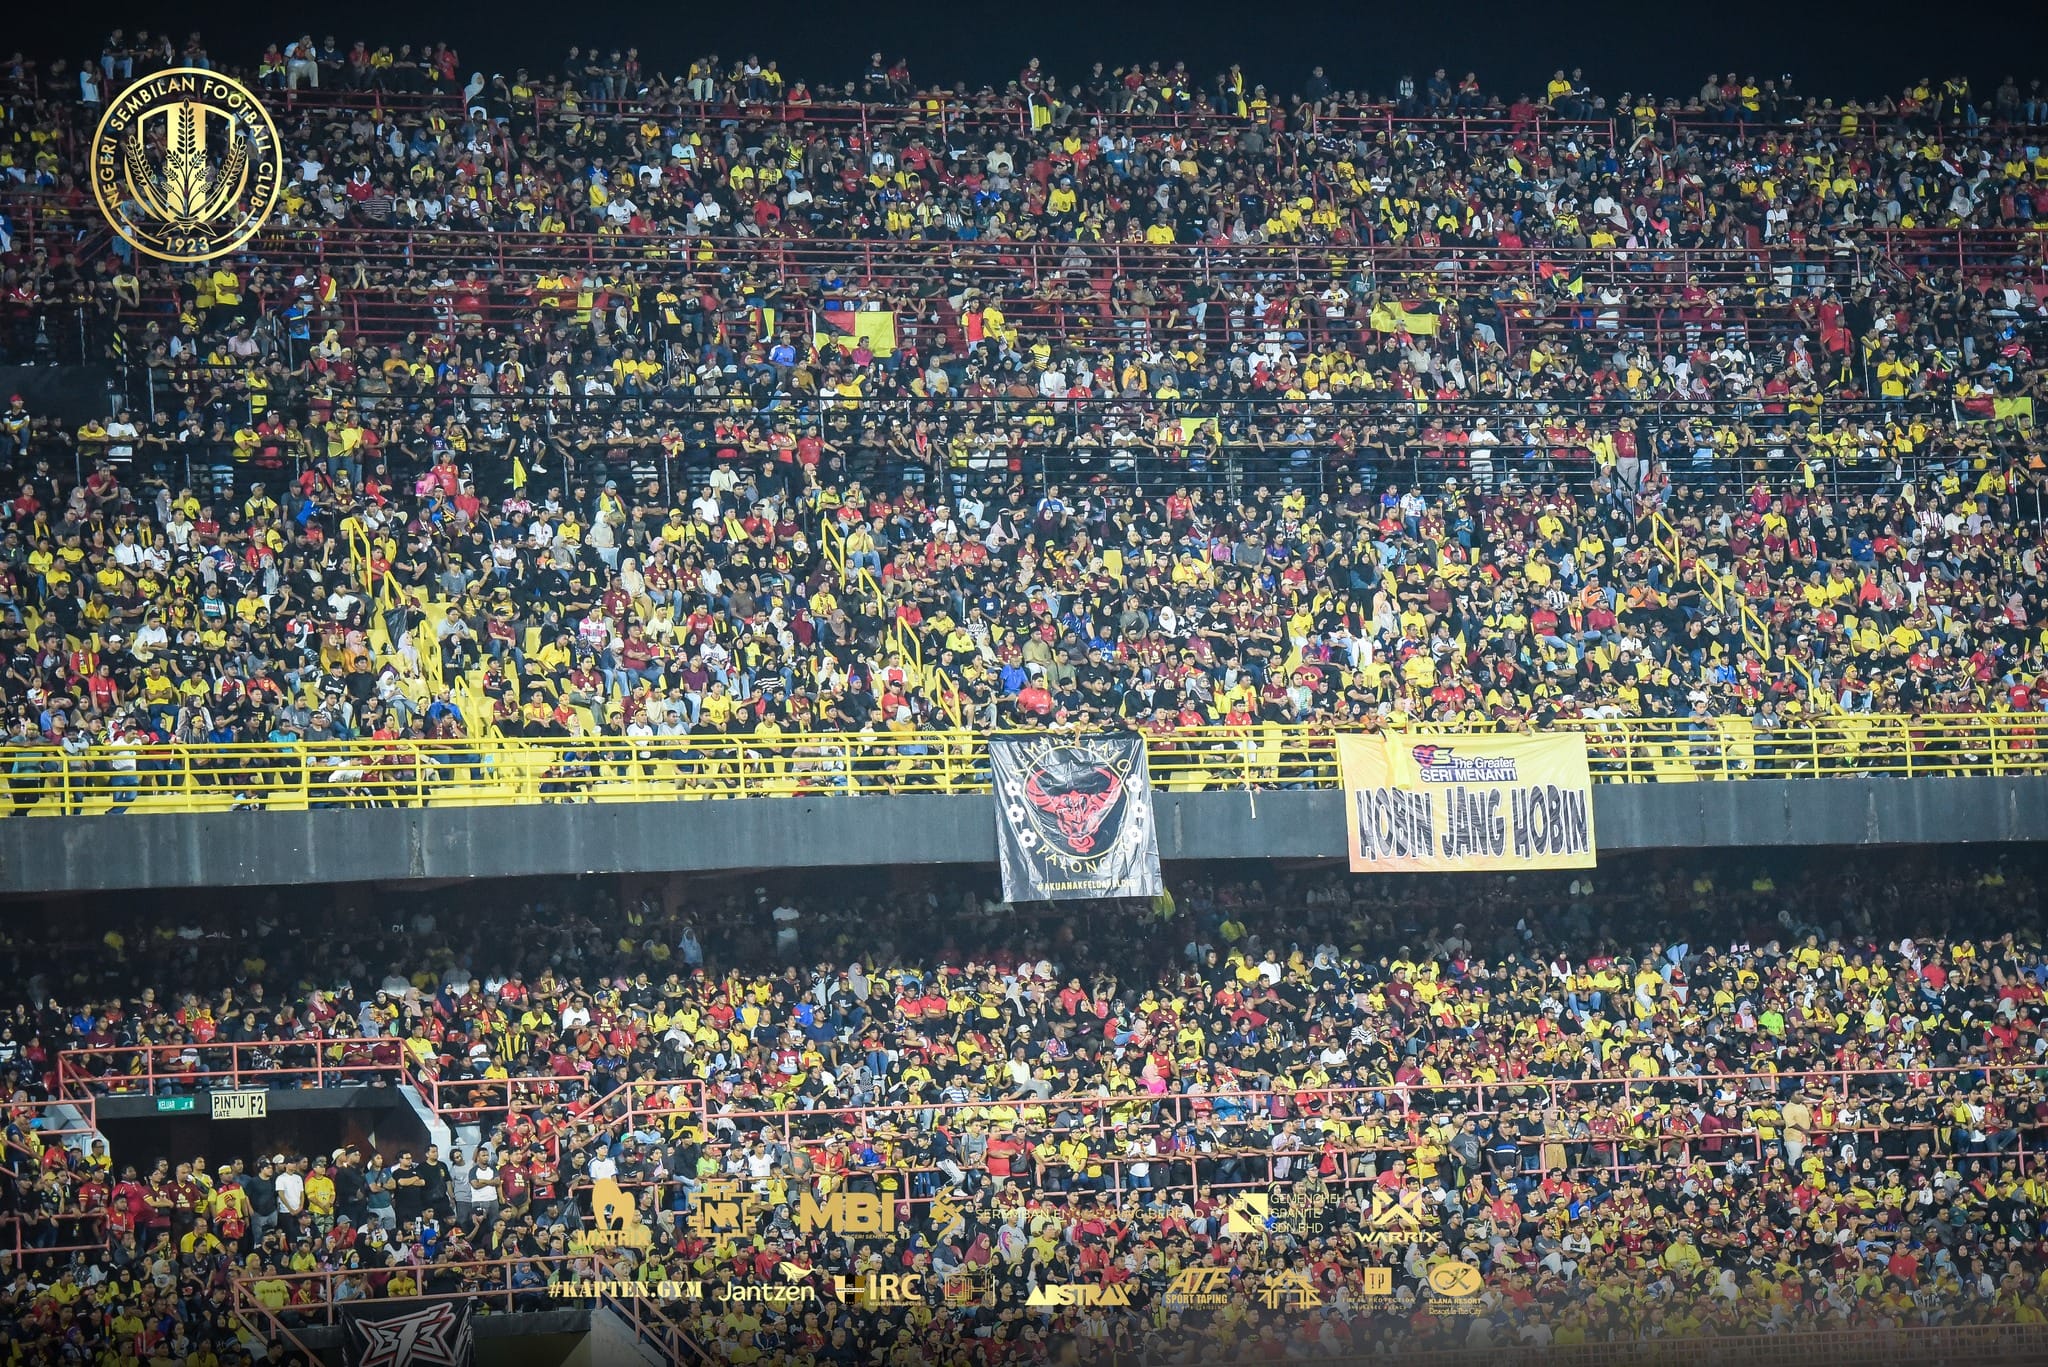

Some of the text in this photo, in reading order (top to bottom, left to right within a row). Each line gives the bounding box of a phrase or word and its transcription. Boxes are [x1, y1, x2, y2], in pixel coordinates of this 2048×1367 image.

[1452, 757, 1514, 769] The Greater
[1421, 768, 1517, 782] SERI MENANTI
[1441, 785, 1505, 862] JANG
[1036, 843, 1111, 873] PALONG
[783, 1056, 796, 1068] 15
[214, 1095, 264, 1115] PINTU F2
[214, 1110, 230, 1118] GATE
